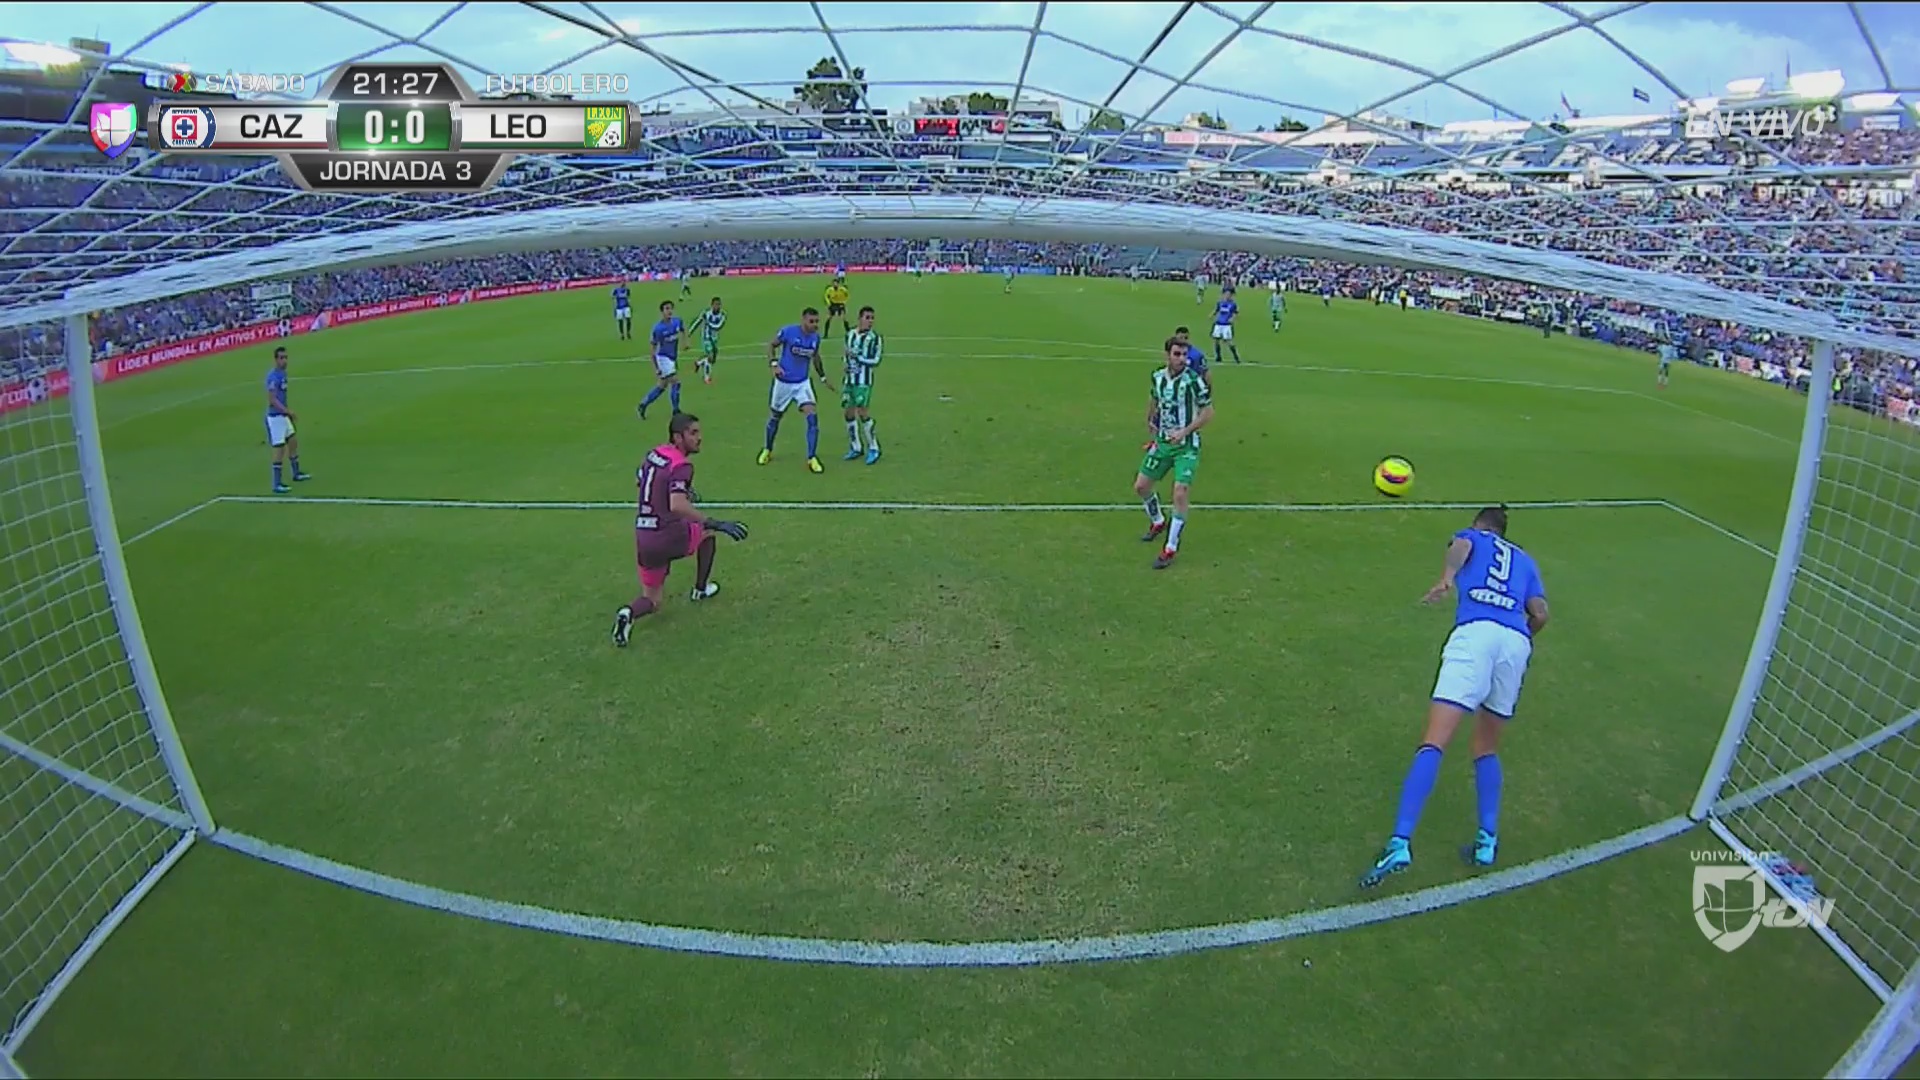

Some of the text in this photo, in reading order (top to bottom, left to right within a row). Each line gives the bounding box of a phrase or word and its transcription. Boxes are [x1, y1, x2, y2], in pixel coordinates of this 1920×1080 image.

[151, 342, 198, 364] MUNDIAL
[199, 339, 214, 352] EN
[214, 330, 256, 348] ADITIVOS
[1489, 539, 1512, 580] 3
